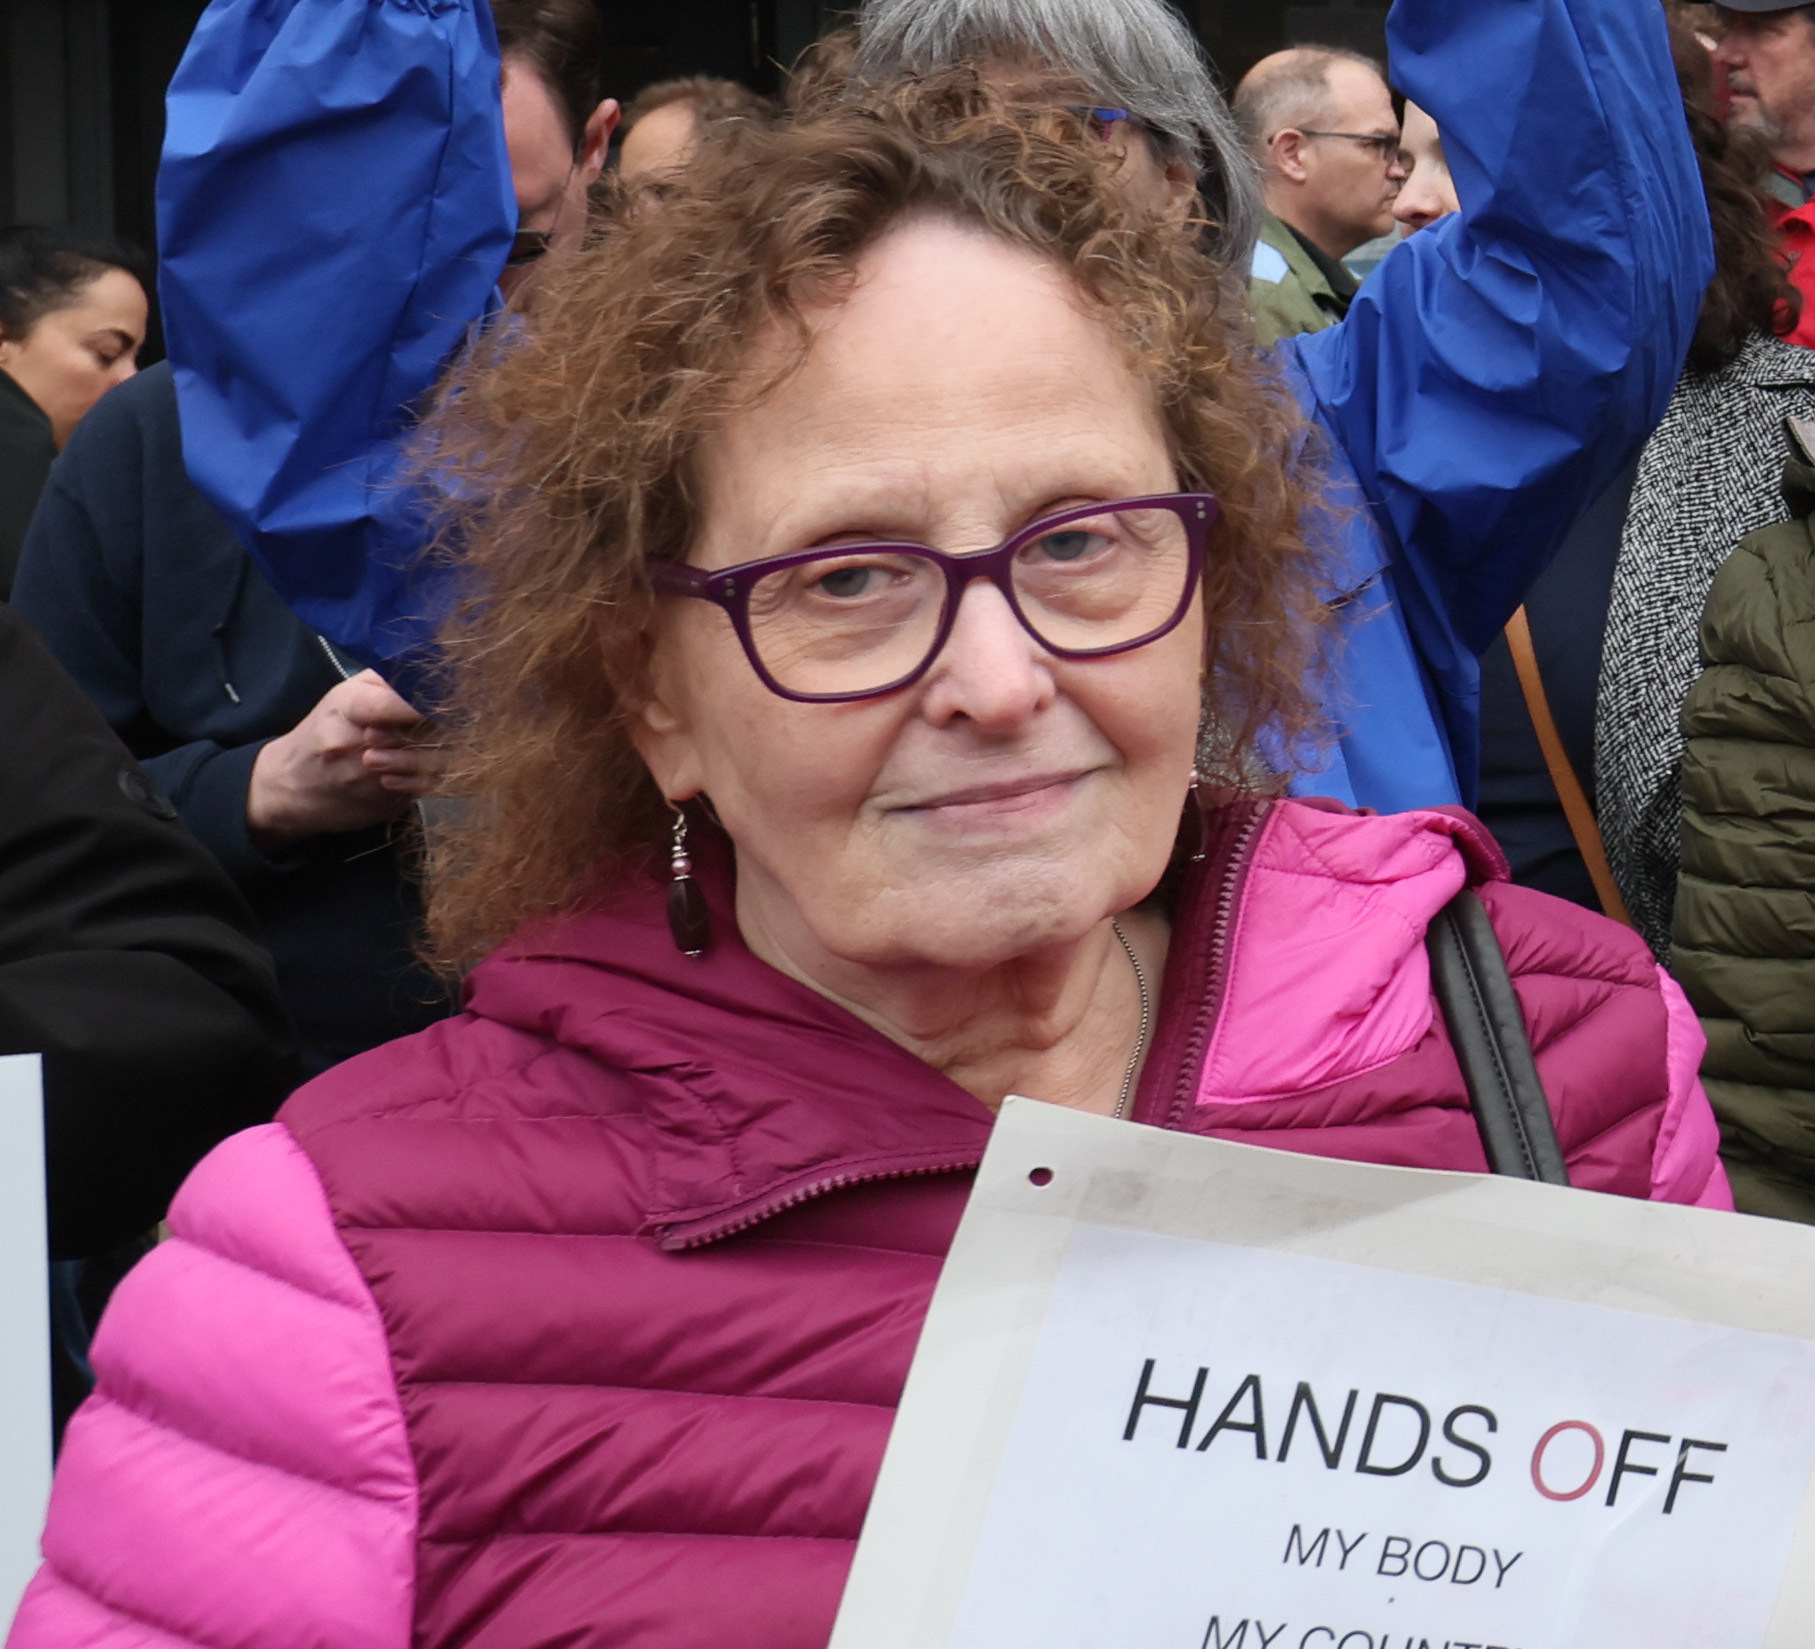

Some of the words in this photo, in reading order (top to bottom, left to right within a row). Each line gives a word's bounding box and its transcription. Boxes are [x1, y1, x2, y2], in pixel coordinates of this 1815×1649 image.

[1122, 1357, 1499, 1489] HANDS
[1530, 1418, 1729, 1515] OFF
[1282, 1523, 1368, 1572] MY
[1376, 1535, 1524, 1590] BODY
